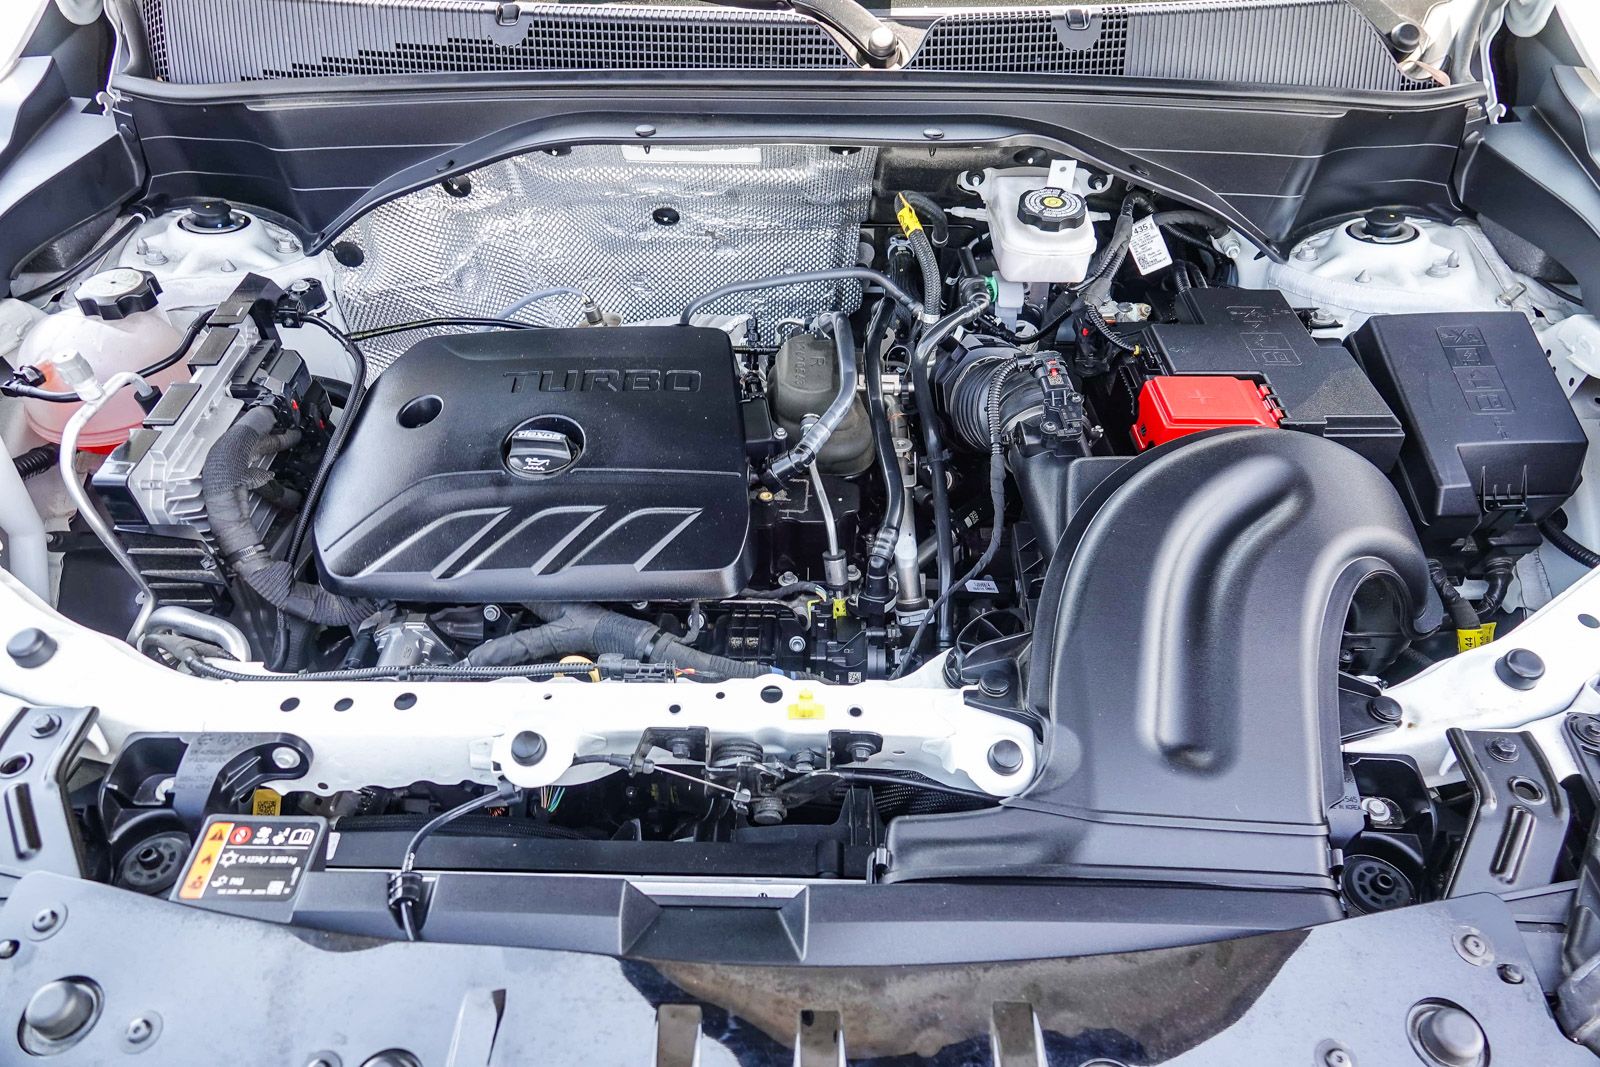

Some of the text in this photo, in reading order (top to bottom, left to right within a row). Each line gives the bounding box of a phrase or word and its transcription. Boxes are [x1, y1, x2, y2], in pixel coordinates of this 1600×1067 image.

[1133, 223, 1149, 234] 435
[503, 369, 702, 393] TURBO
[518, 429, 561, 441] dexos
